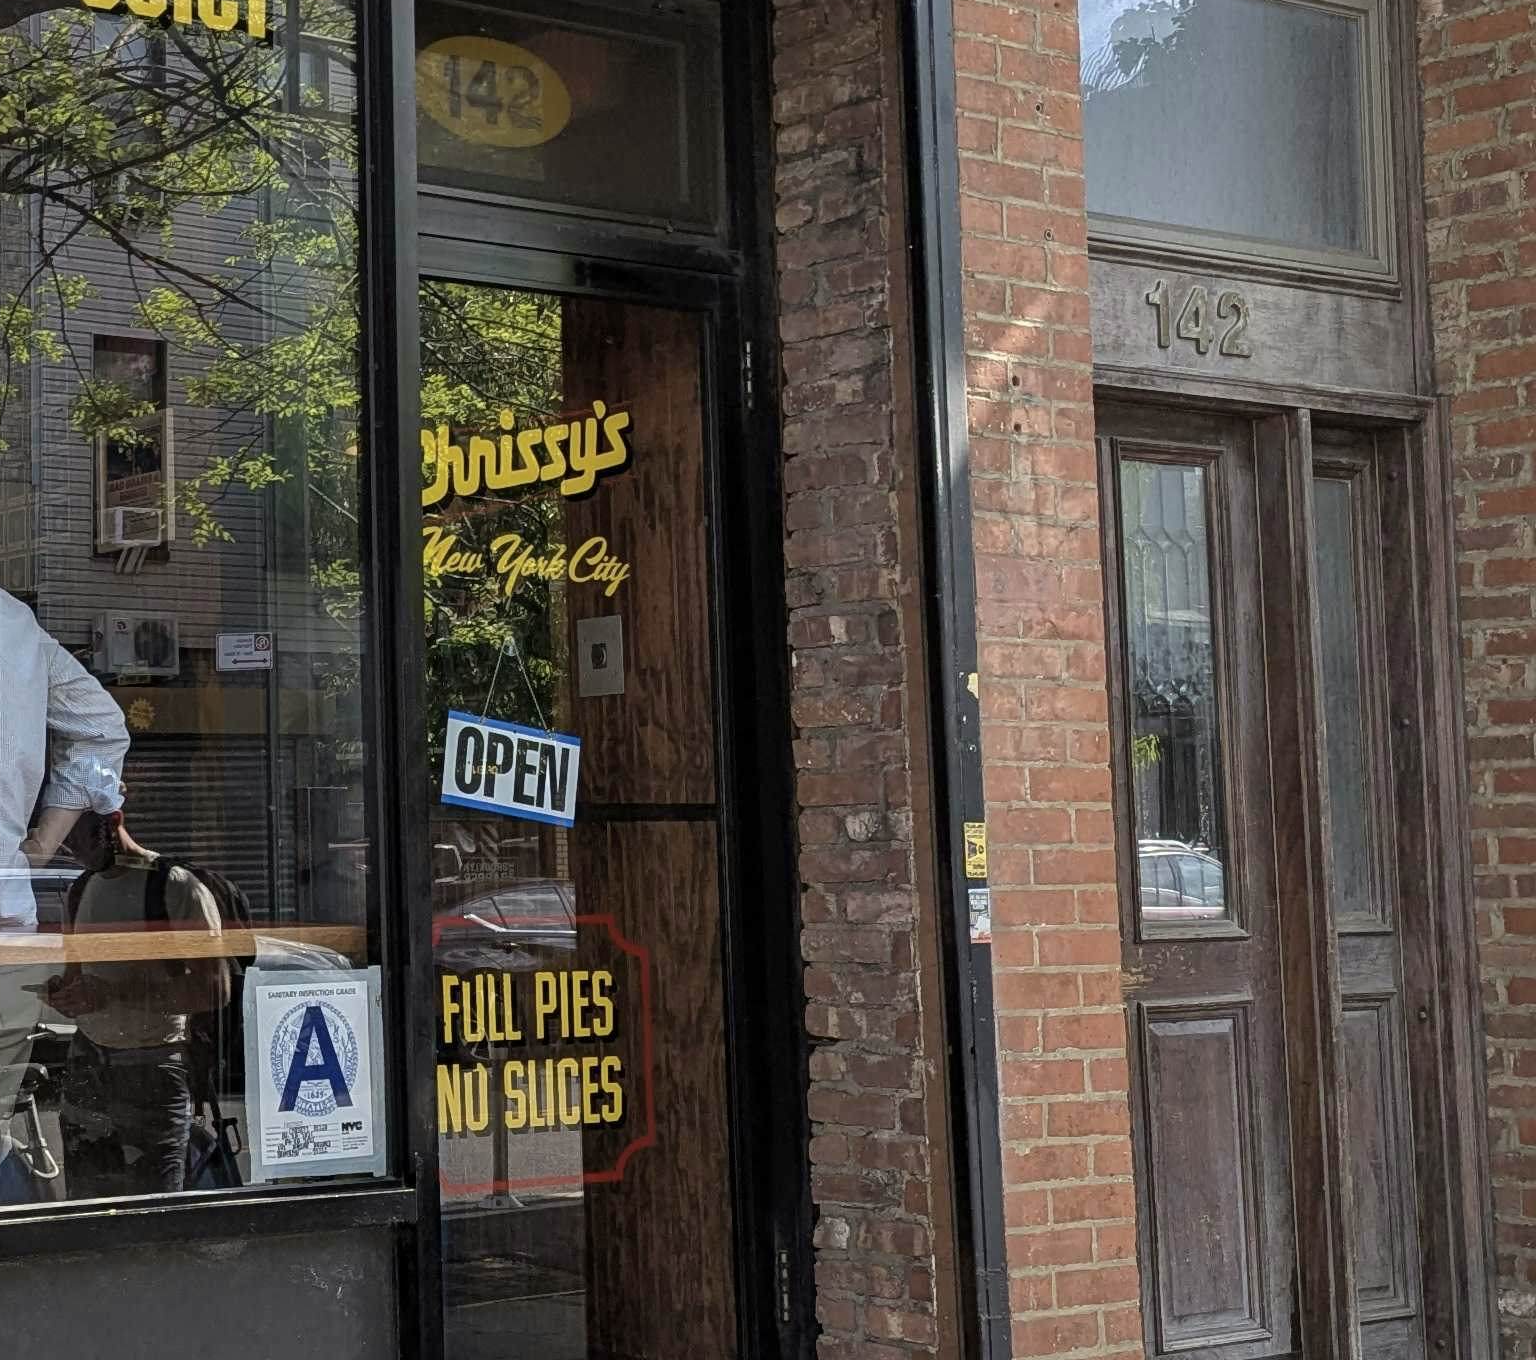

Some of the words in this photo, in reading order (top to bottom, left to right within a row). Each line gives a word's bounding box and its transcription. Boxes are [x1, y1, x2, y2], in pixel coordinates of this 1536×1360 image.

[441, 54, 543, 130] 142
[1145, 279, 1252, 359] 142
[423, 526, 484, 577] New
[490, 533, 567, 598] York
[568, 536, 630, 597] City
[454, 726, 570, 812] OPEN
[441, 973, 522, 1044] FULL
[534, 970, 615, 1040] PIES
[277, 1005, 354, 1113] A
[437, 1062, 489, 1134] NO
[504, 1055, 623, 1131] SLICES
[341, 1121, 363, 1132] NYC
